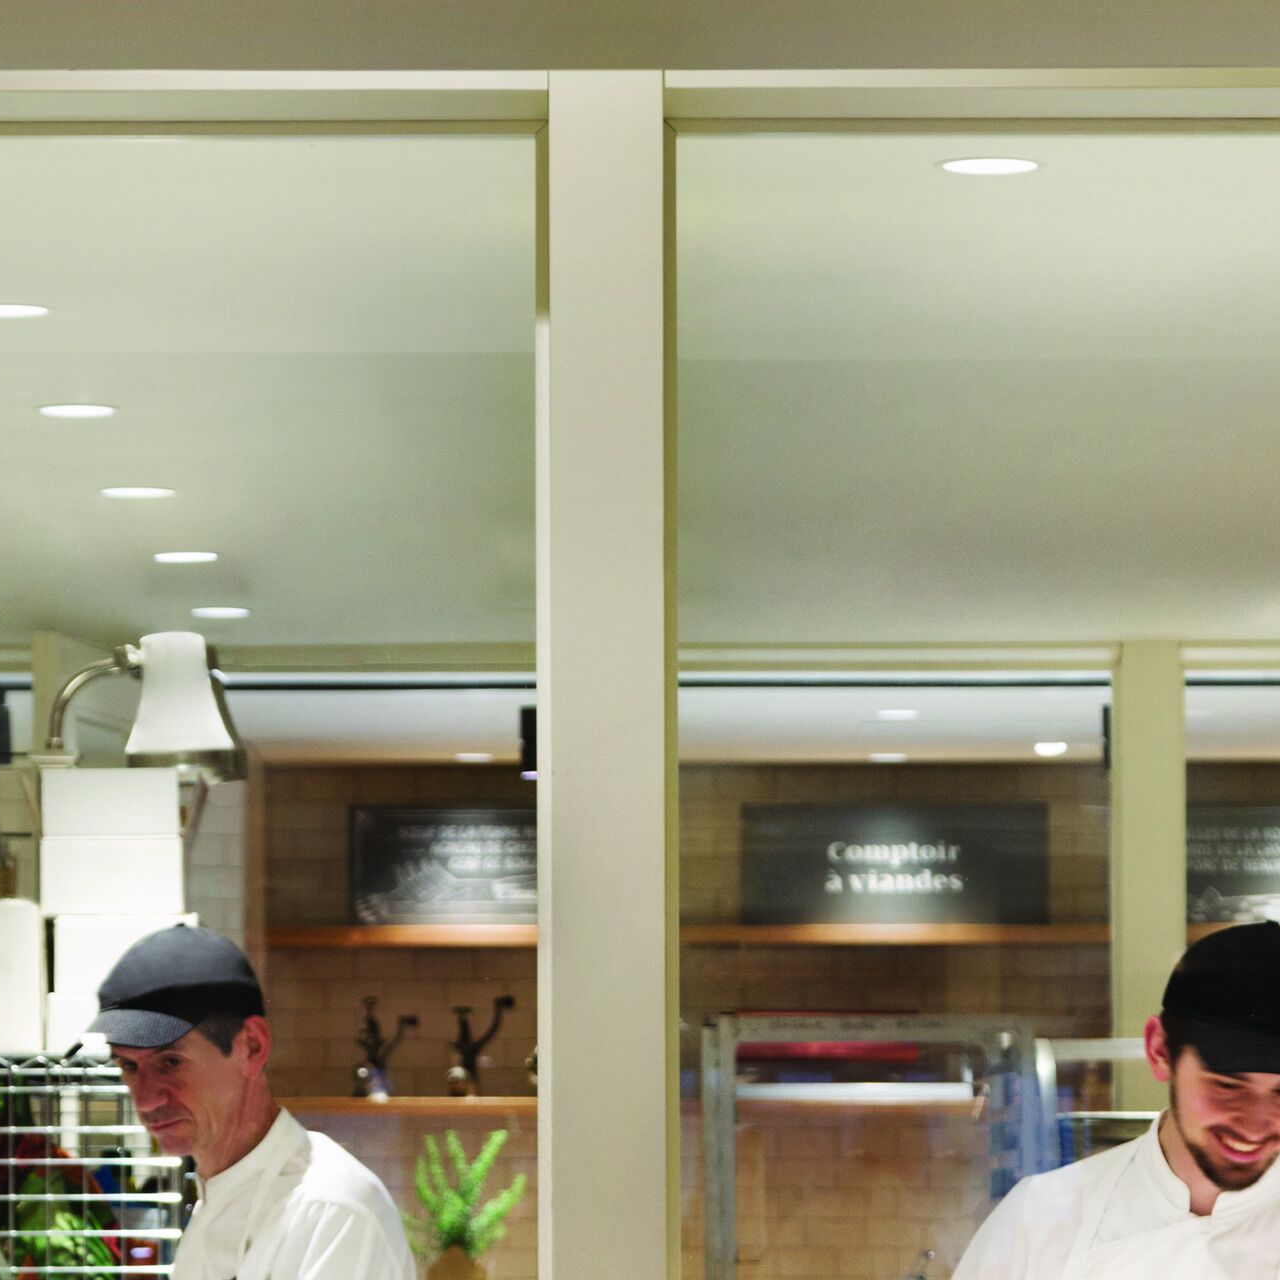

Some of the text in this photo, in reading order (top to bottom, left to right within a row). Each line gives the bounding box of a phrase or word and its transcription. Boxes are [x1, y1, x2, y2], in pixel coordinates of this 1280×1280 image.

[826, 841, 960, 868] Comptoir
[824, 868, 963, 893] à viandes
